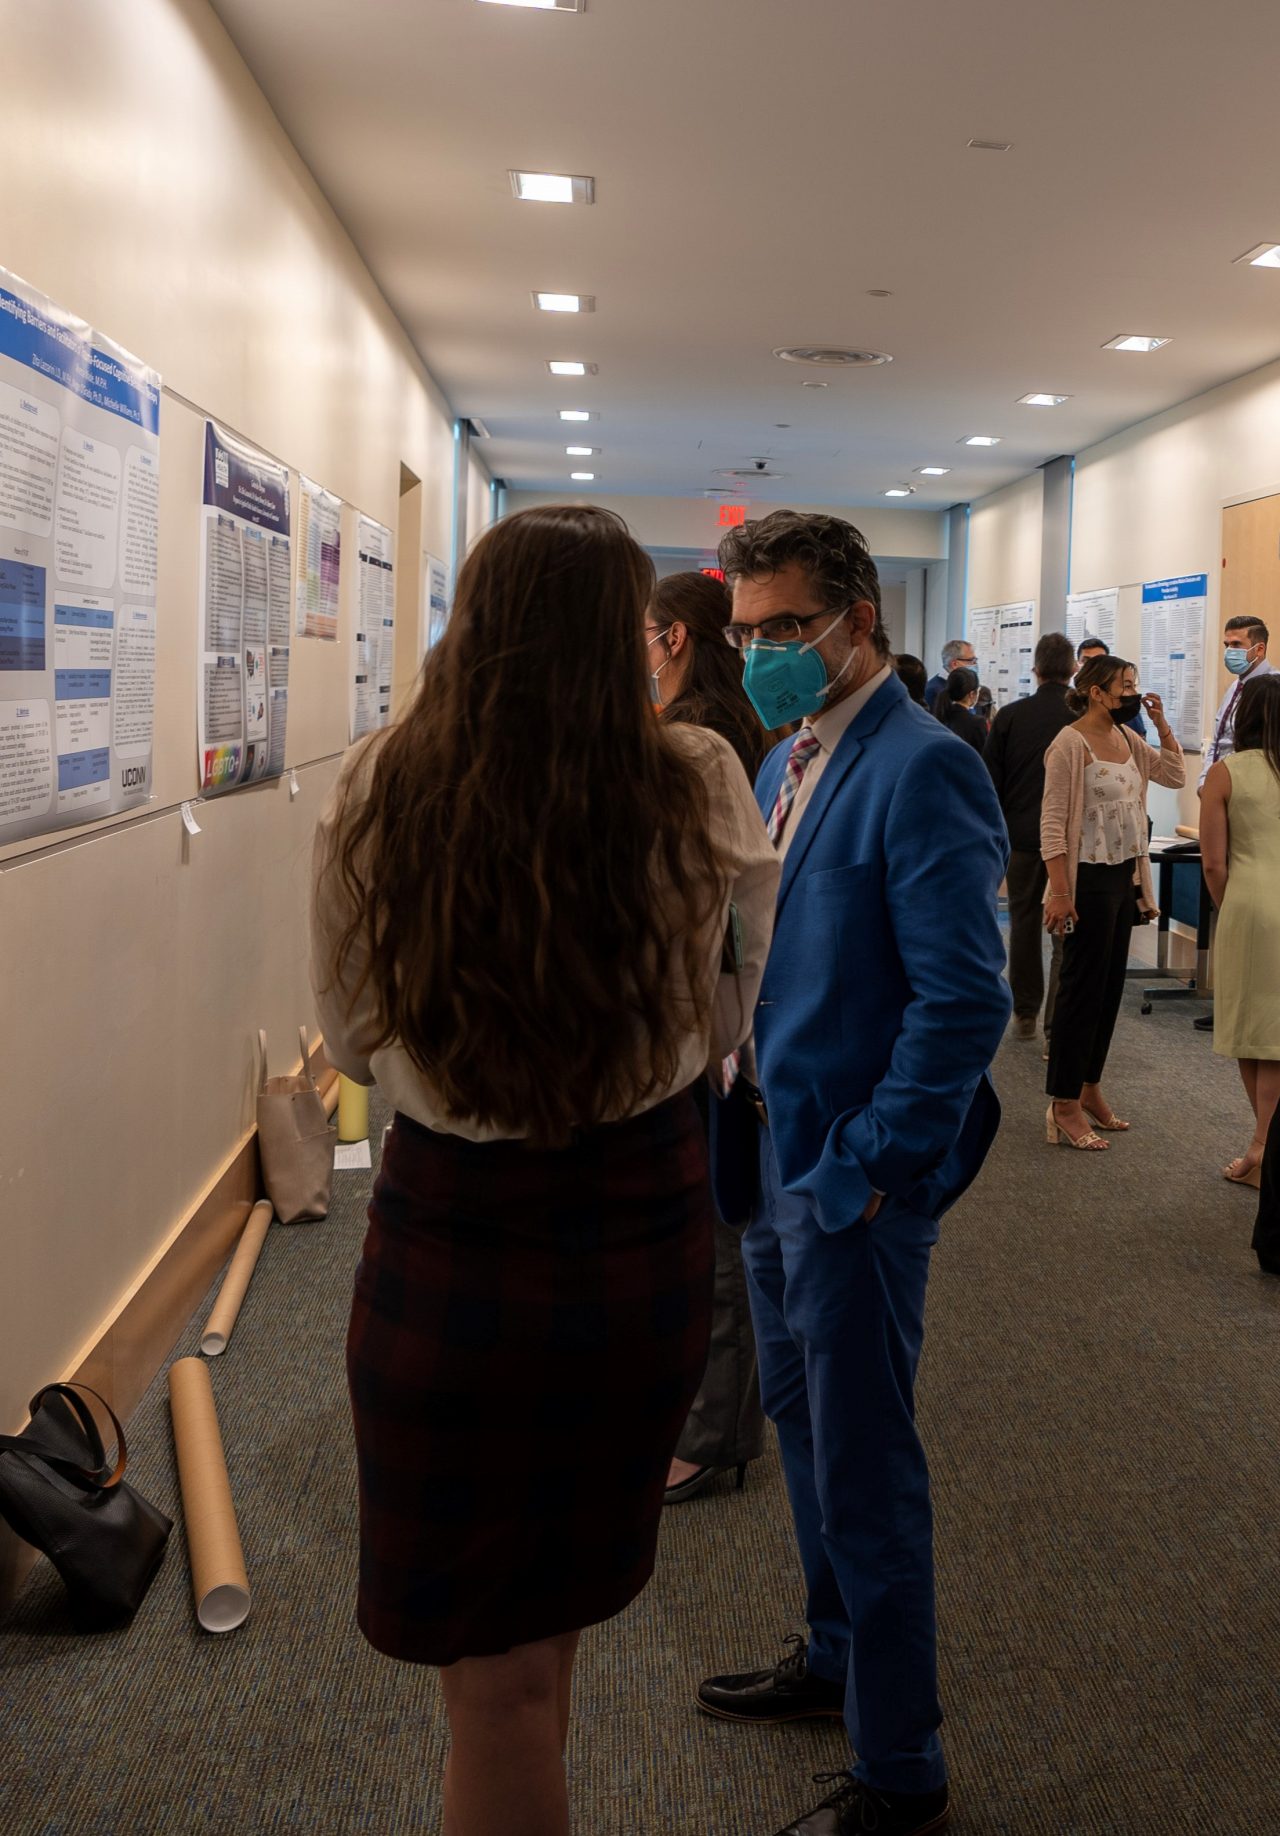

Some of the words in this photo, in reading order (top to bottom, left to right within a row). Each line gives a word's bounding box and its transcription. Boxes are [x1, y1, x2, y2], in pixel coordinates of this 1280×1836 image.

[0, 293, 27, 324] entifying
[27, 309, 47, 333] Barriers
[48, 325, 56, 338] and
[720, 505, 744, 526] EXIT
[122, 767, 146, 788] UCONN
[206, 755, 240, 779] LGBTQ+
